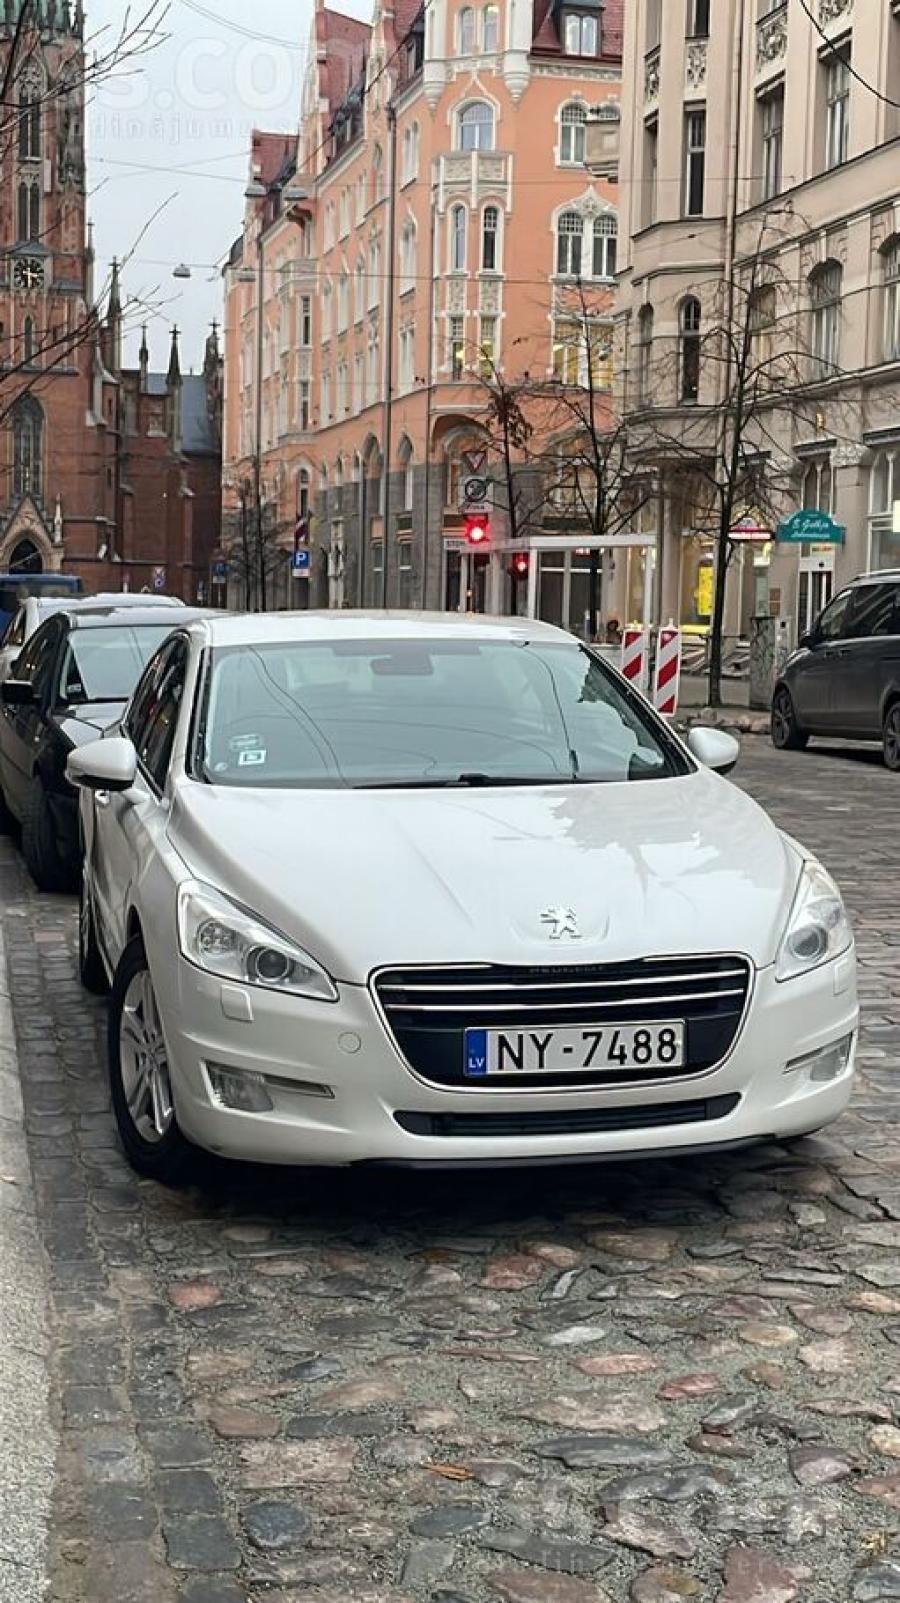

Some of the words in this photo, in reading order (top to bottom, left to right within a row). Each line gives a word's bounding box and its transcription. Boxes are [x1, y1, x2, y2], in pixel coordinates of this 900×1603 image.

[296, 552, 306, 565] P
[468, 1056, 485, 1068] LV
[497, 1027, 677, 1070] NY-7488
